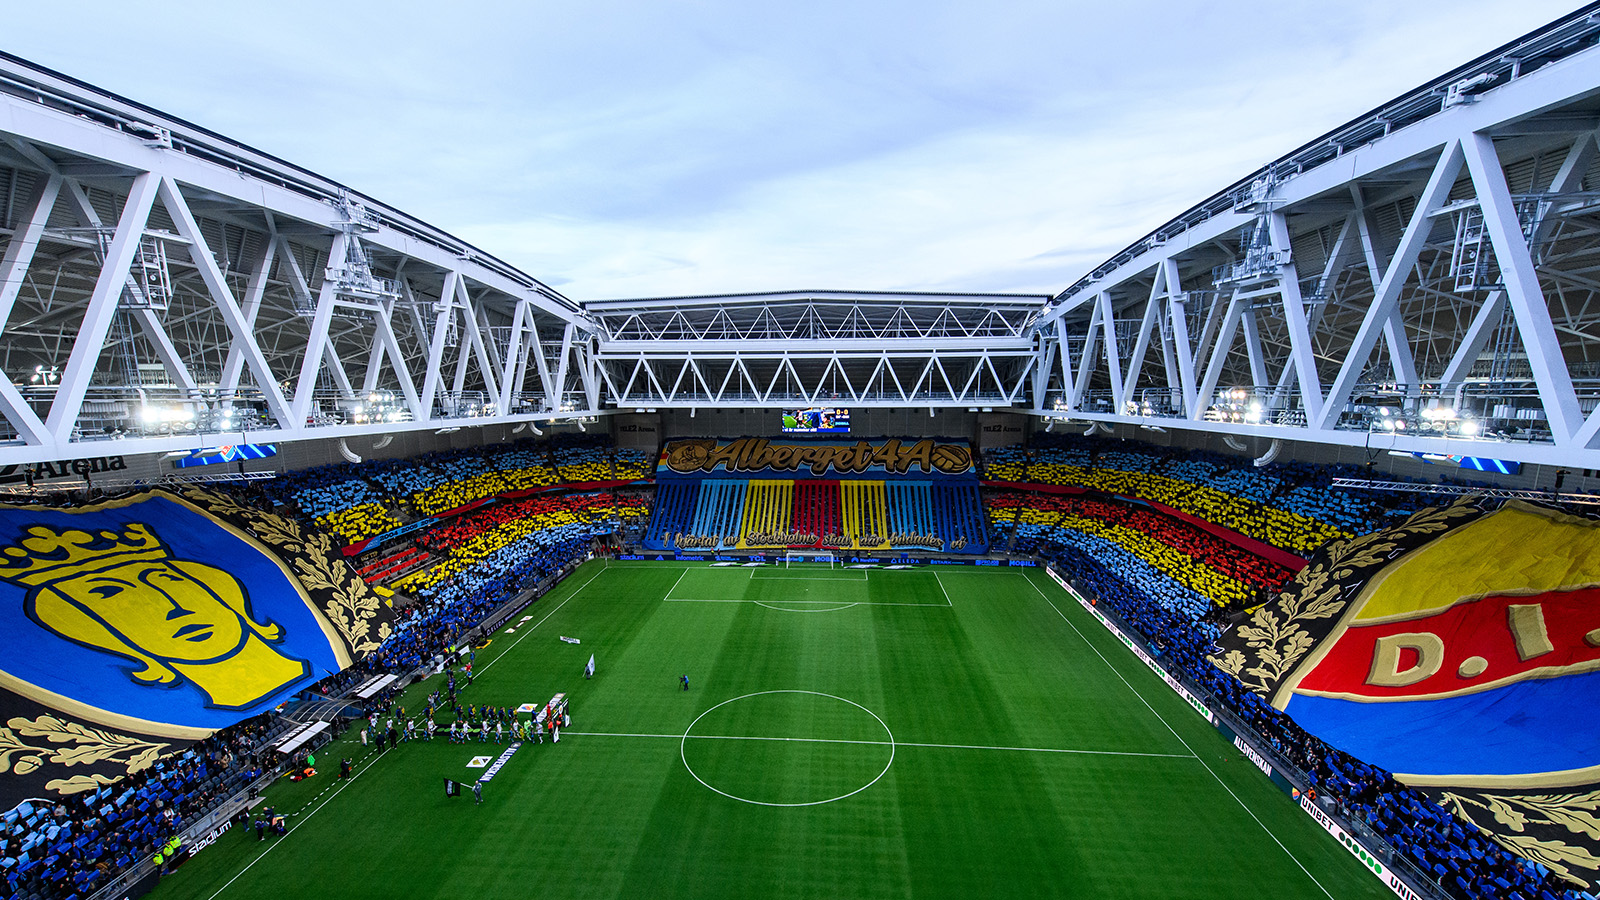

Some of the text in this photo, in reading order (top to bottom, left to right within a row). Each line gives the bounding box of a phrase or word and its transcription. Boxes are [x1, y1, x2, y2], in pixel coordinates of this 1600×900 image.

[34, 456, 127, 480] Arena
[674, 532, 719, 549] hjärtat
[723, 535, 740, 546] av
[745, 530, 819, 546] Stockholms
[859, 533, 886, 547] där
[889, 531, 945, 547] bildades
[950, 536, 968, 550] vi
[1166, 676, 1184, 695] UNIBET
[1233, 735, 1273, 777] ALLSVENSKAN
[1302, 796, 1335, 831] UNIBET
[188, 820, 233, 858] stadium
